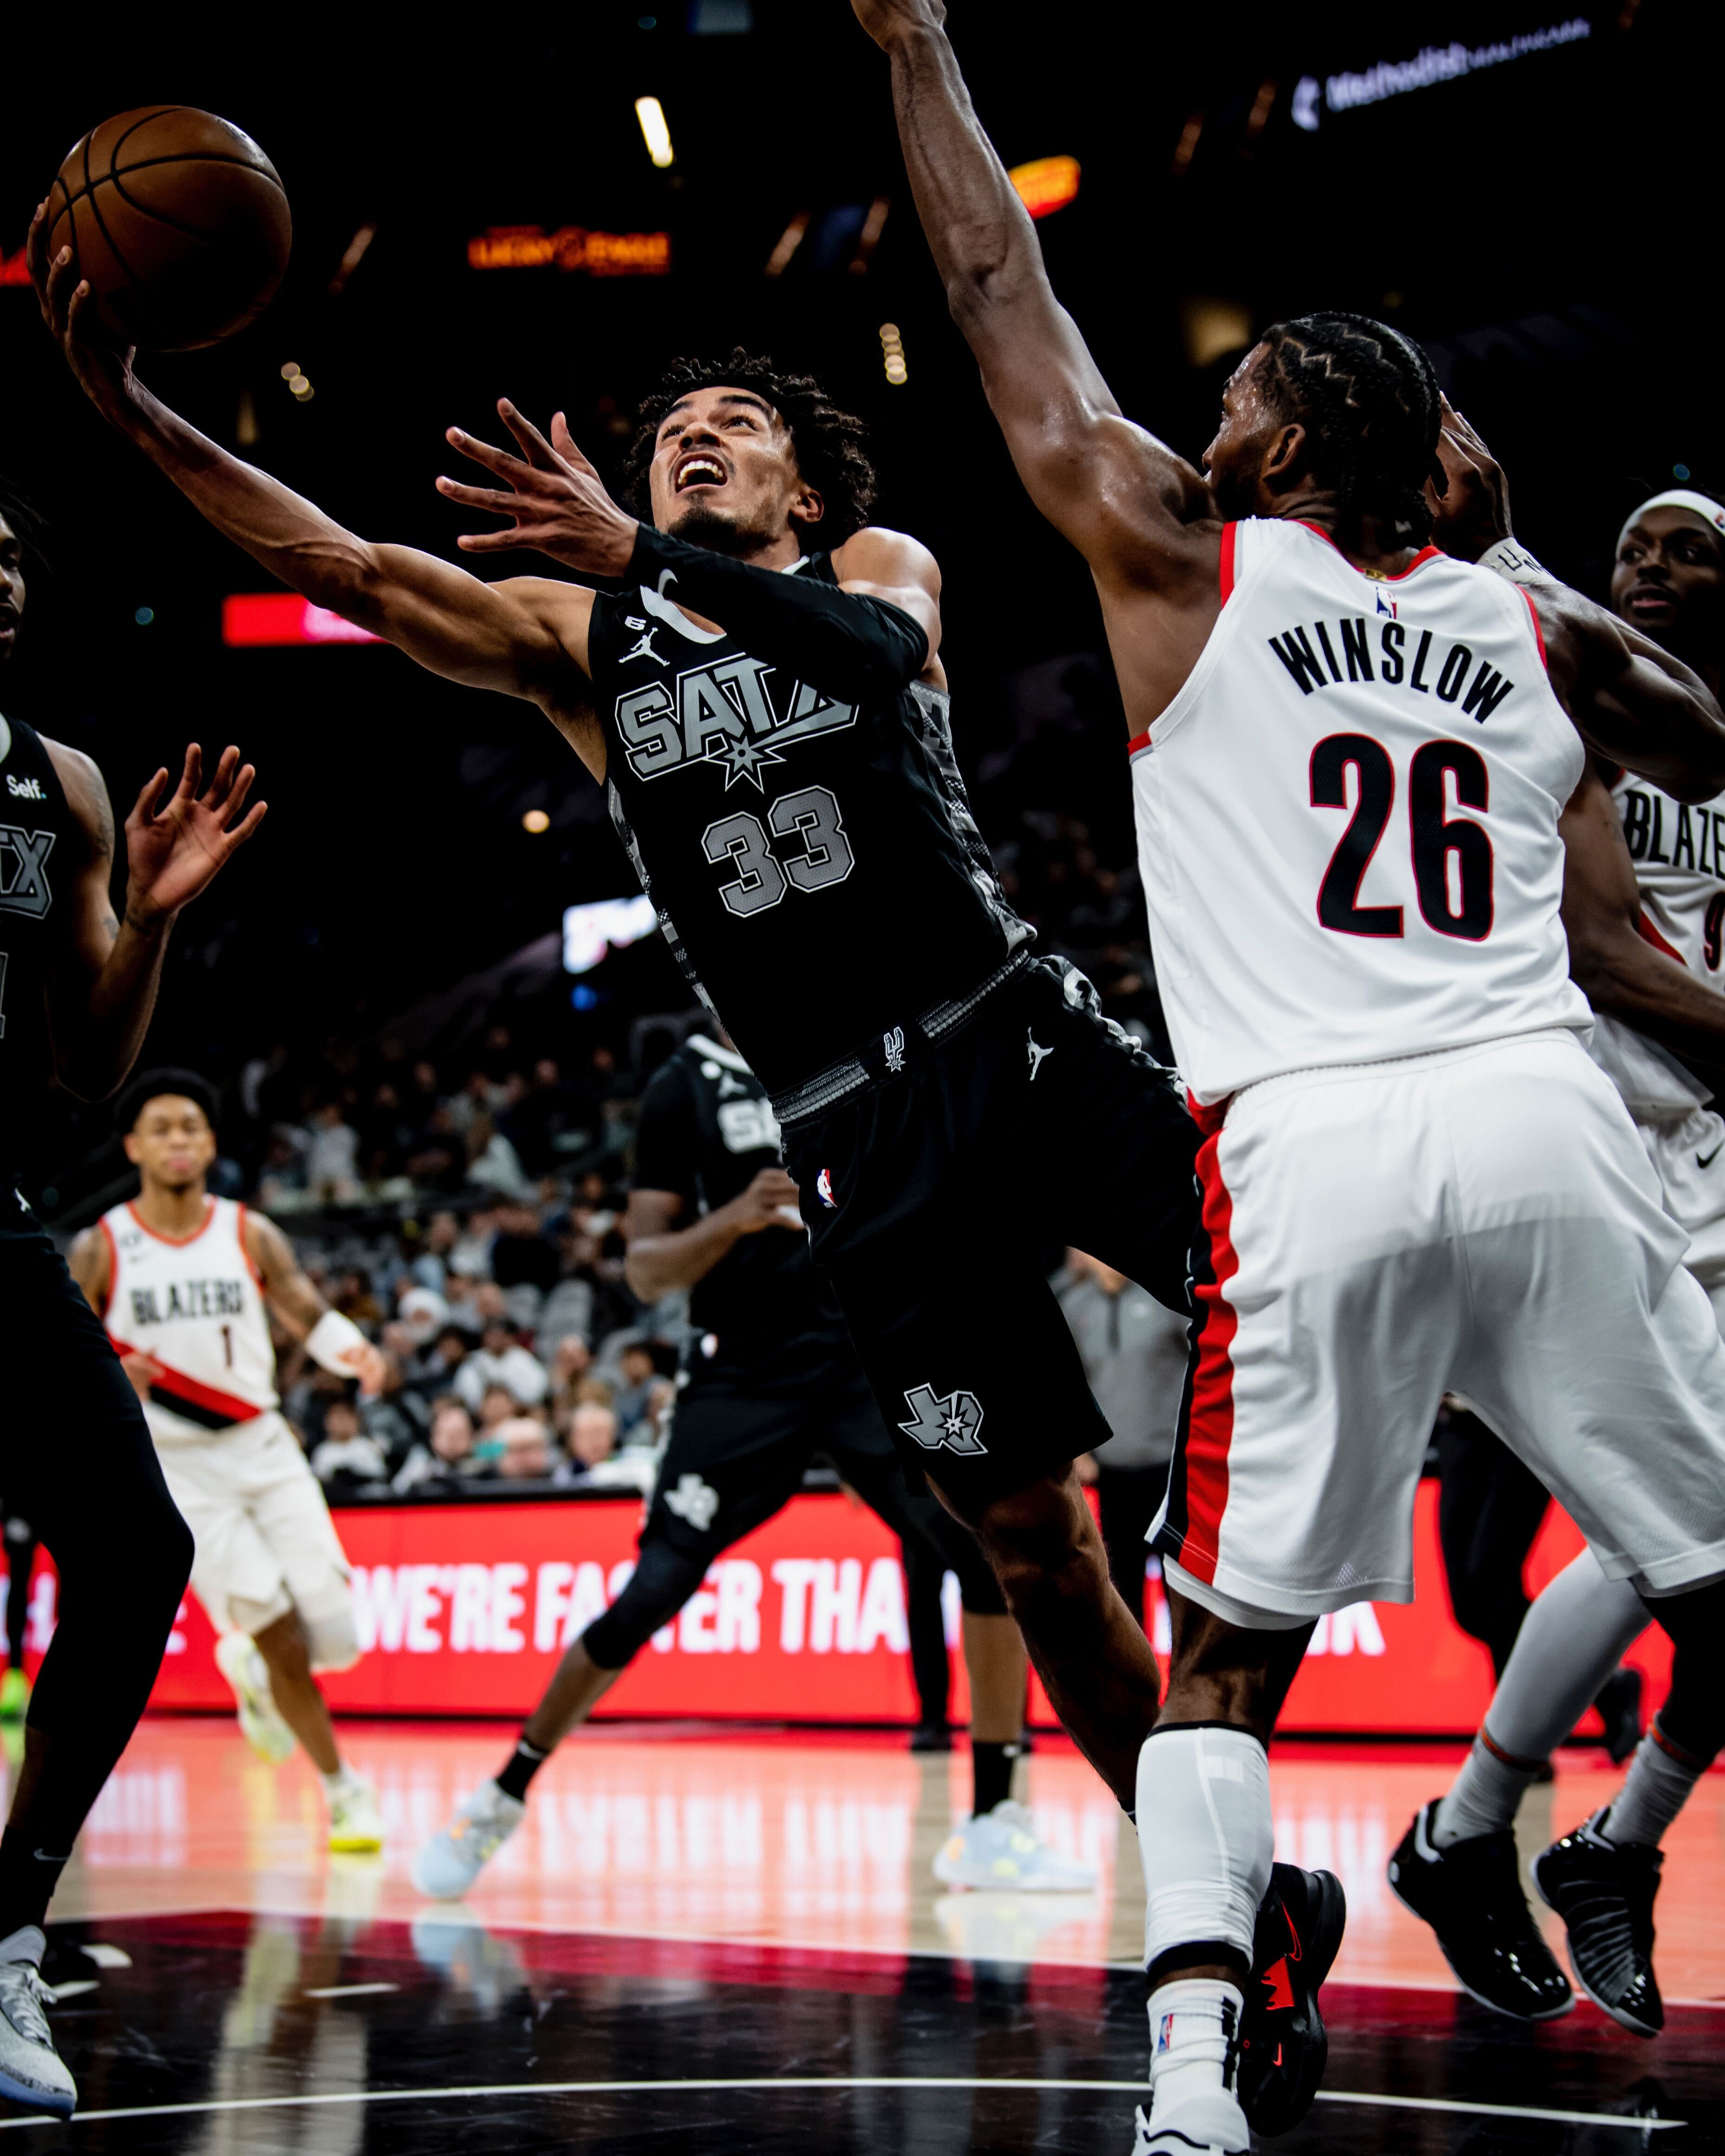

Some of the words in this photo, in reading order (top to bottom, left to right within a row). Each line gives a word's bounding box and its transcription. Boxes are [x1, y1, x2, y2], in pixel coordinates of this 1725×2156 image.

[625, 615, 646, 631] 6
[1268, 618, 1514, 724] WINSLOW
[6, 774, 47, 800] Self.
[701, 785, 855, 918] 33
[1309, 732, 1494, 942] 26
[220, 1324, 234, 1370] 1
[351, 1563, 529, 1654] WE'RE
[534, 1560, 763, 1655] FAER
